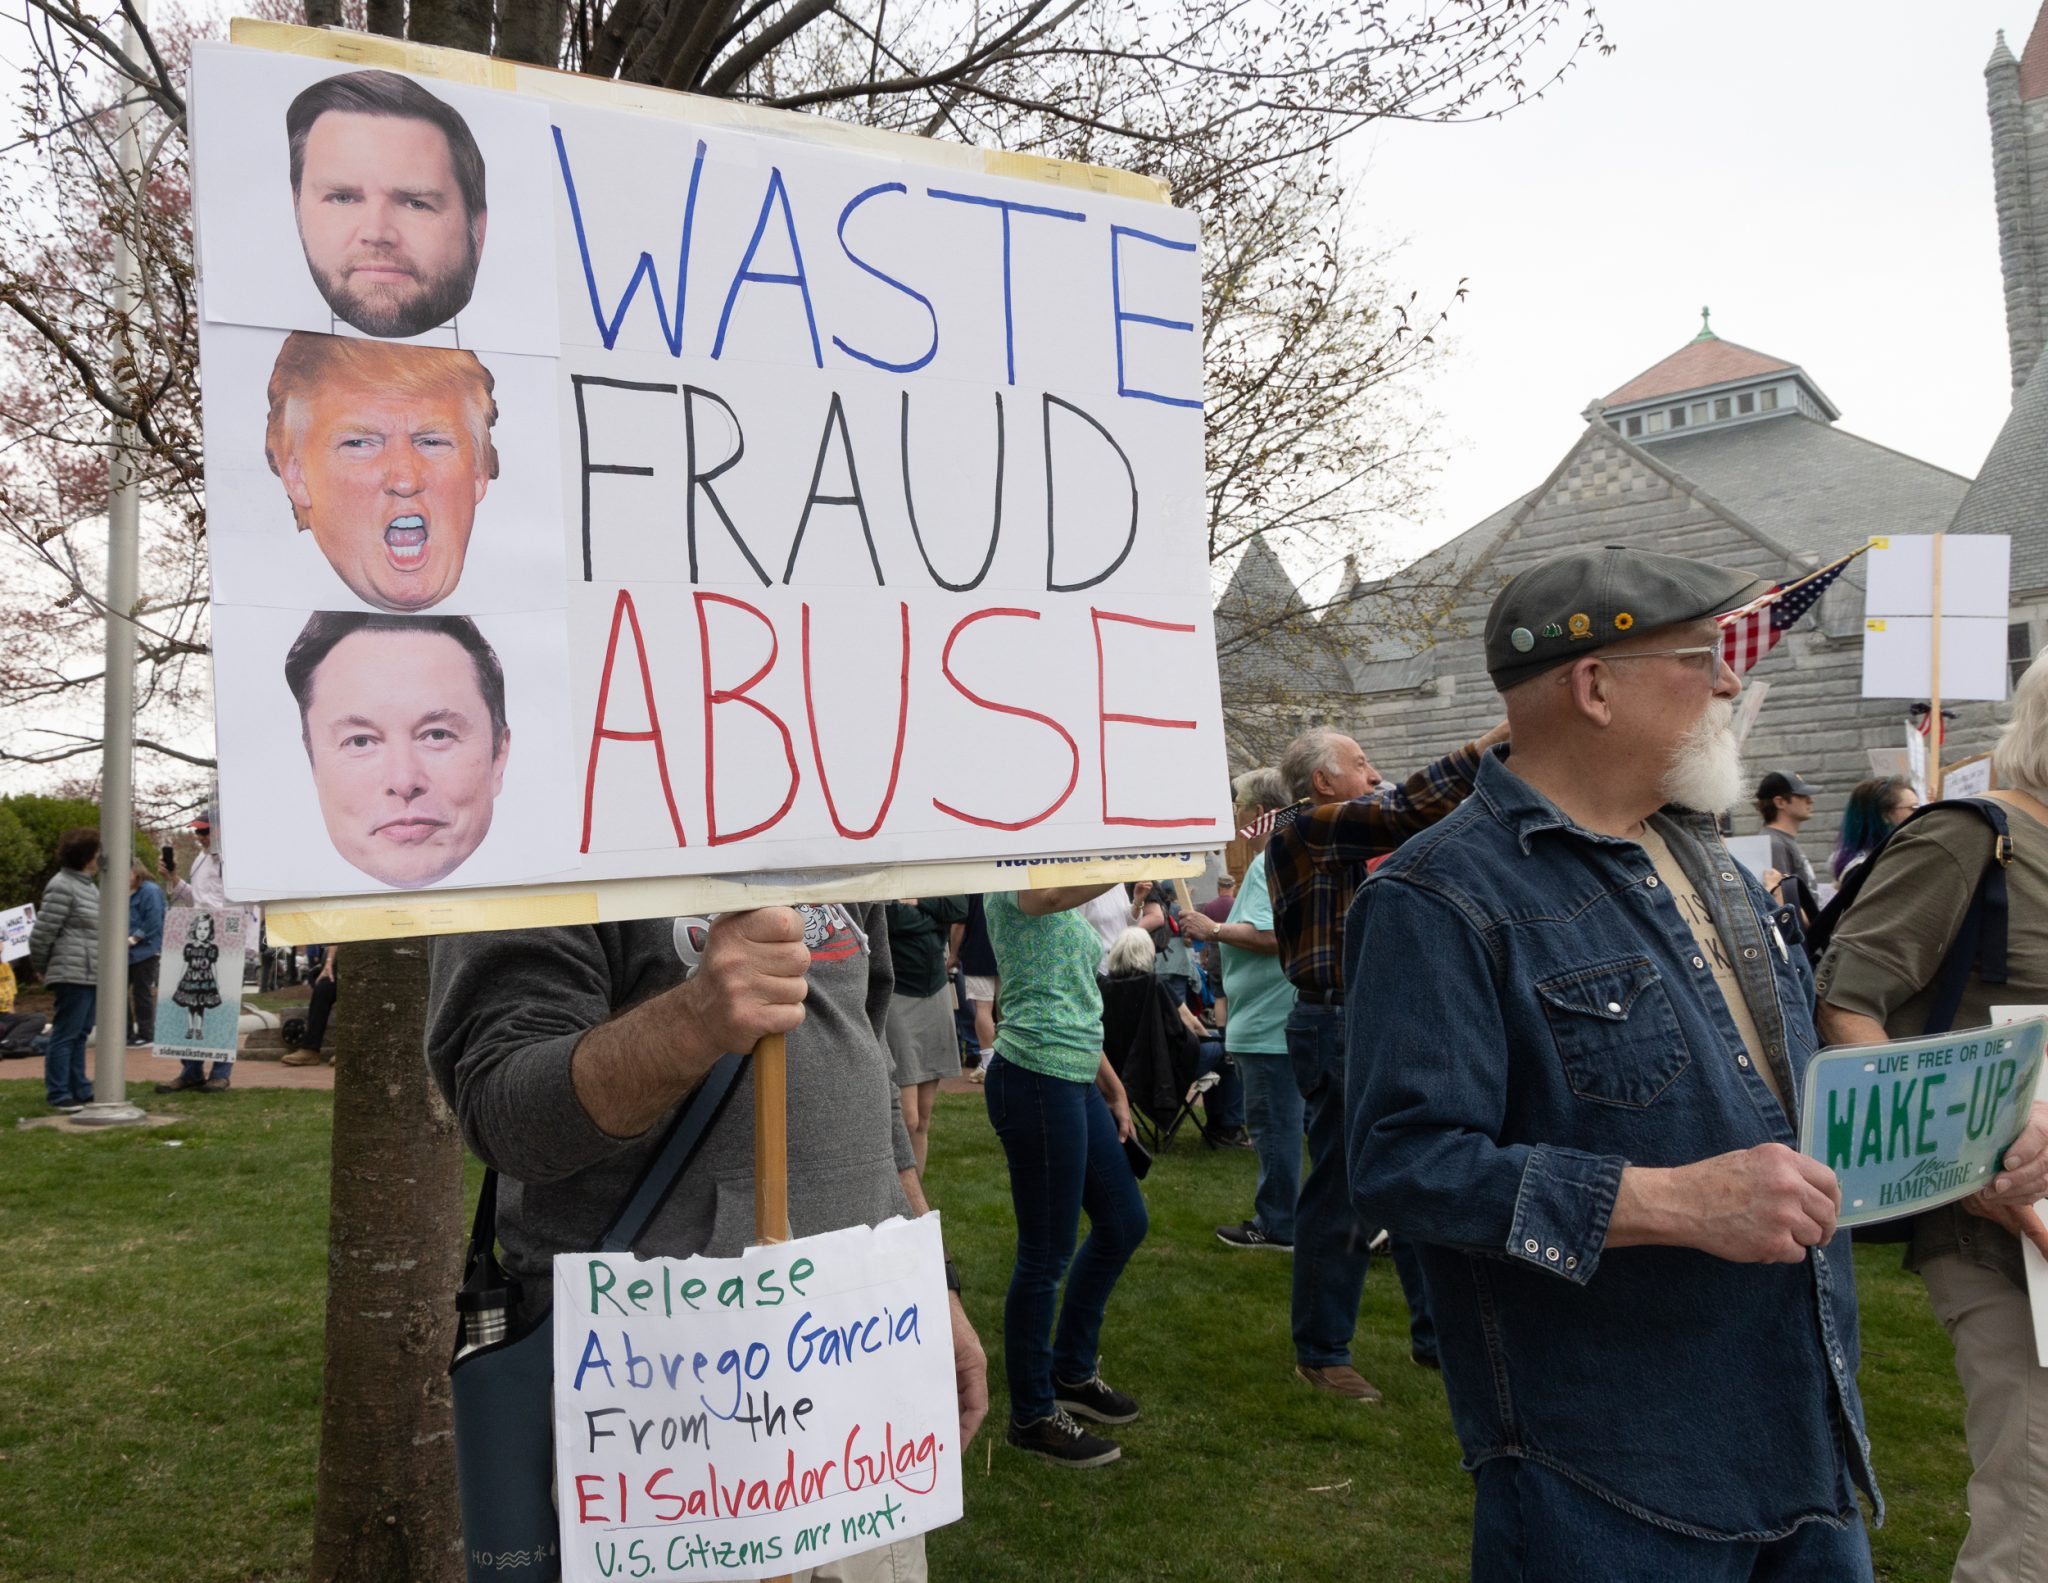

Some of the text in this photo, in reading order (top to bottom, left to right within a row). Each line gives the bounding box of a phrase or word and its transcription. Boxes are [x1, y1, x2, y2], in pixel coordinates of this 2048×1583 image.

[550, 124, 1204, 409] WASTE
[571, 374, 1138, 592] FRAUD
[580, 589, 1216, 853] ABUSE
[184, 967, 213, 981] SUCH
[191, 957, 209, 970] NO
[159, 1047, 229, 1063] sidewalksteve.org
[1878, 1038, 2005, 1074] LIVE FREE OR DIE
[1826, 1058, 2017, 1170] WAKE-UP
[1879, 1161, 1973, 1206] HAMPSHIRE
[1900, 1156, 1959, 1181] New
[588, 1257, 815, 1318] Release
[573, 1303, 921, 1420] Abrego Garcia
[584, 1390, 814, 1455] From the
[575, 1422, 944, 1524] El Salvador Gulag.
[595, 1493, 906, 1578] U.S. Citizens are next.
